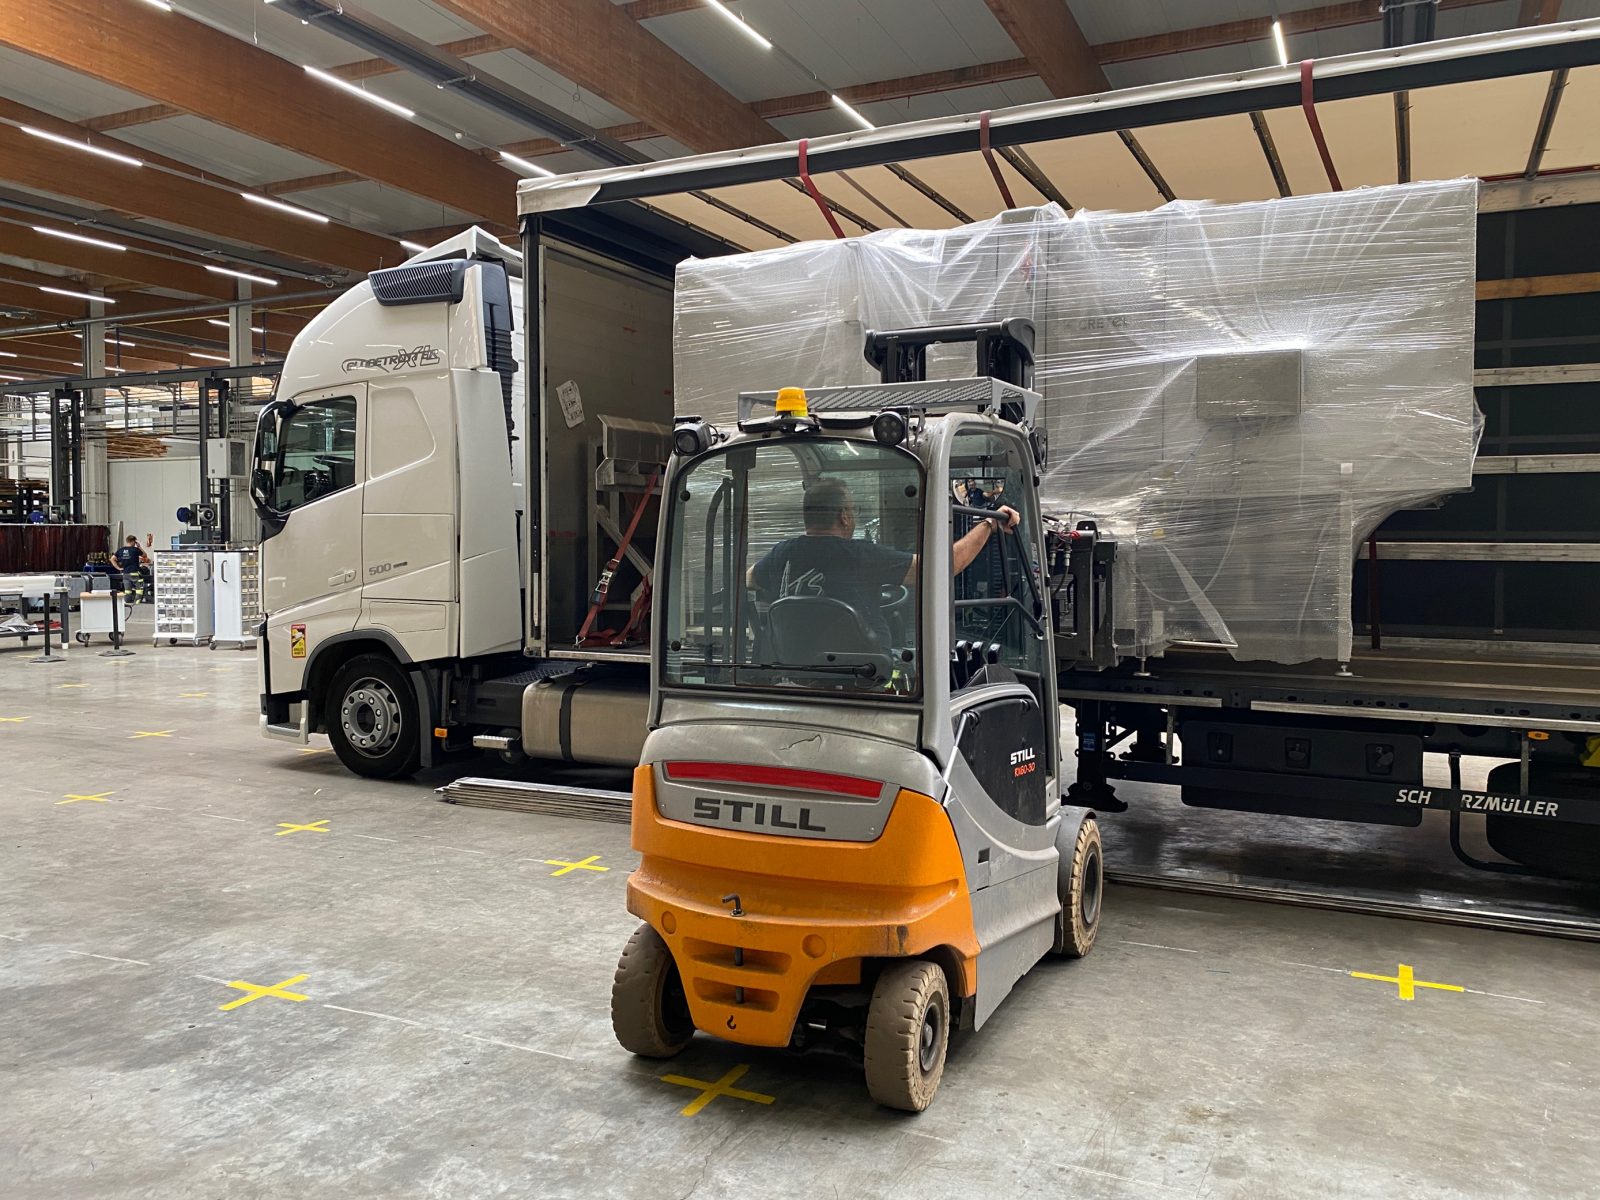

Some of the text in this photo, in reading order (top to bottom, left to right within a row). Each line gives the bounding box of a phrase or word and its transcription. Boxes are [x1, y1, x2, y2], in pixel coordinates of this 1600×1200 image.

[369, 562, 391, 575] 500
[1010, 747, 1035, 765] STILL
[693, 797, 826, 832] STILL
